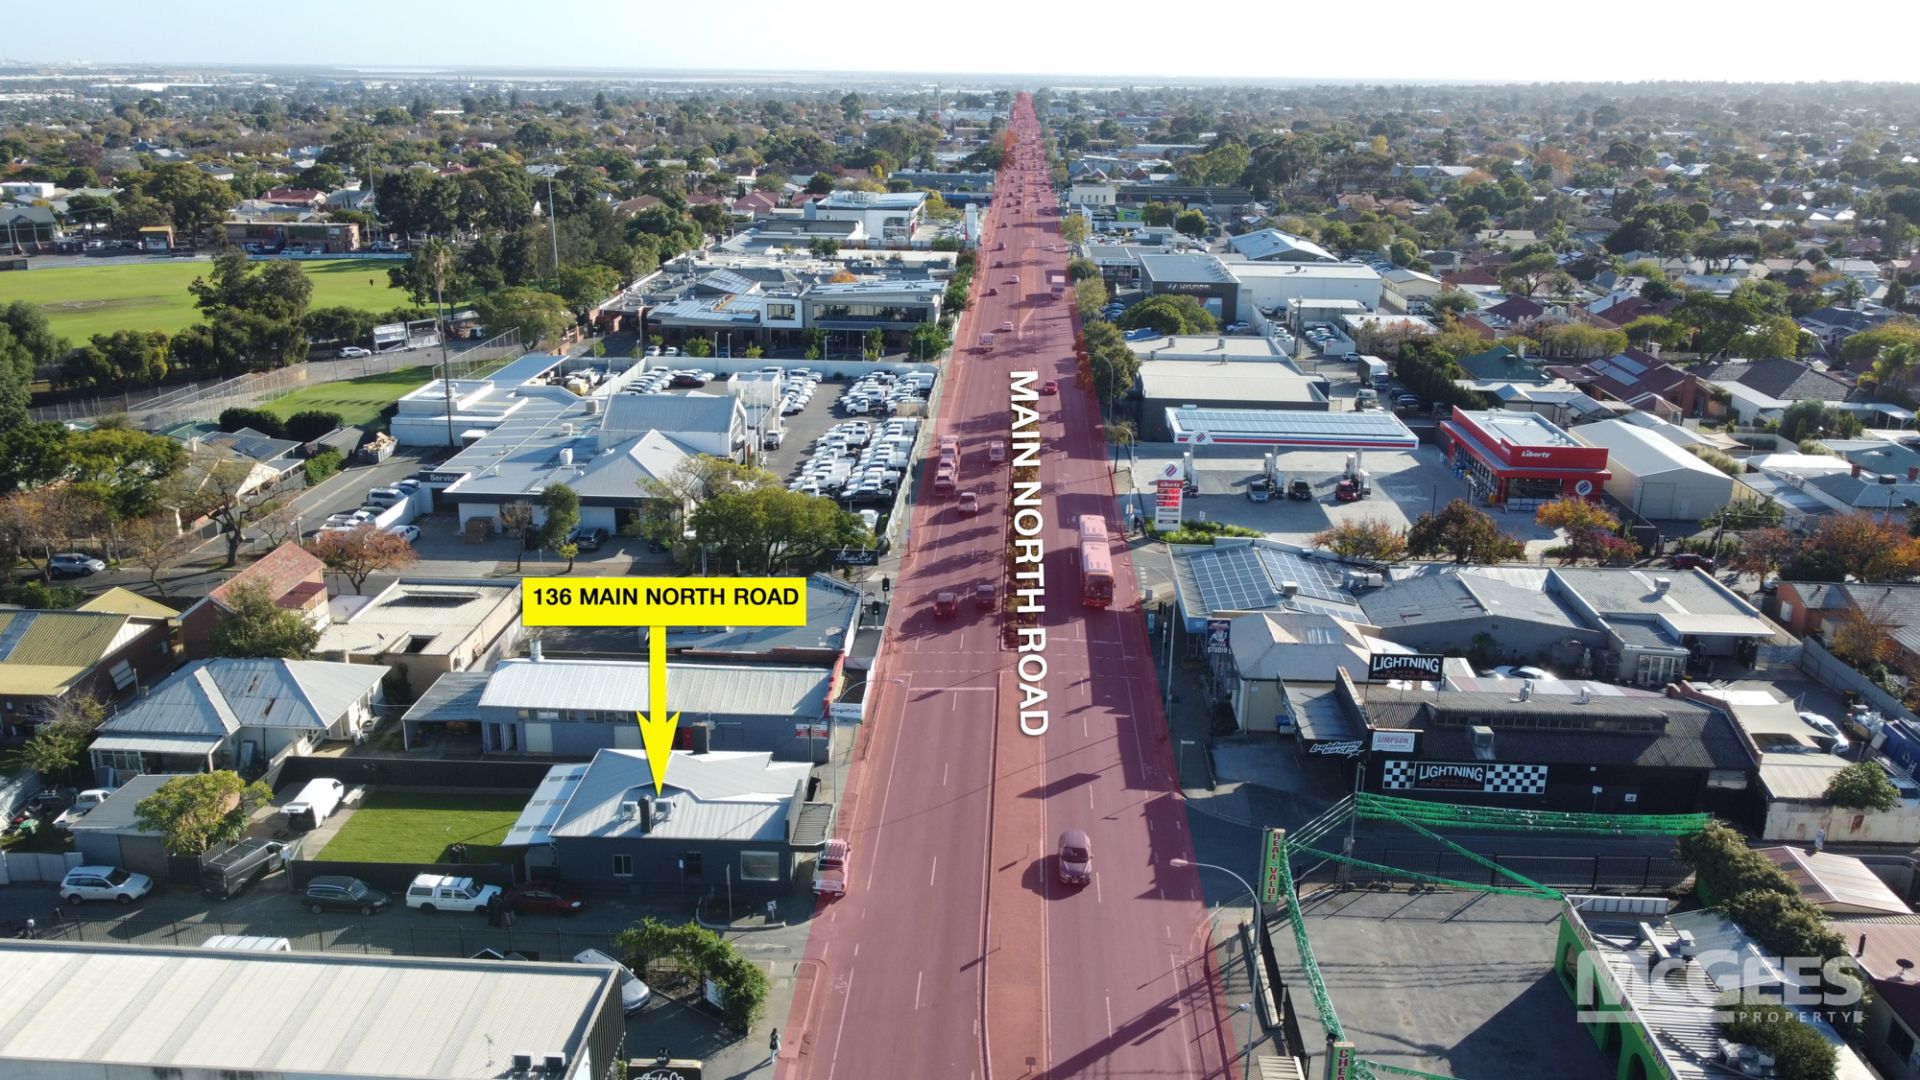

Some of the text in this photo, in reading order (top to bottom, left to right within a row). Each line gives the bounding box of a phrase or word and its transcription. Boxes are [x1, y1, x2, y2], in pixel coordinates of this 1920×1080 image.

[1521, 449, 1551, 458] Liberty
[1373, 656, 1440, 673] LIGHTNING
[1376, 736, 1409, 744] SIMPSON
[1419, 765, 1483, 782] LIGHTNING
[1267, 832, 1281, 902] REAL VALUE
